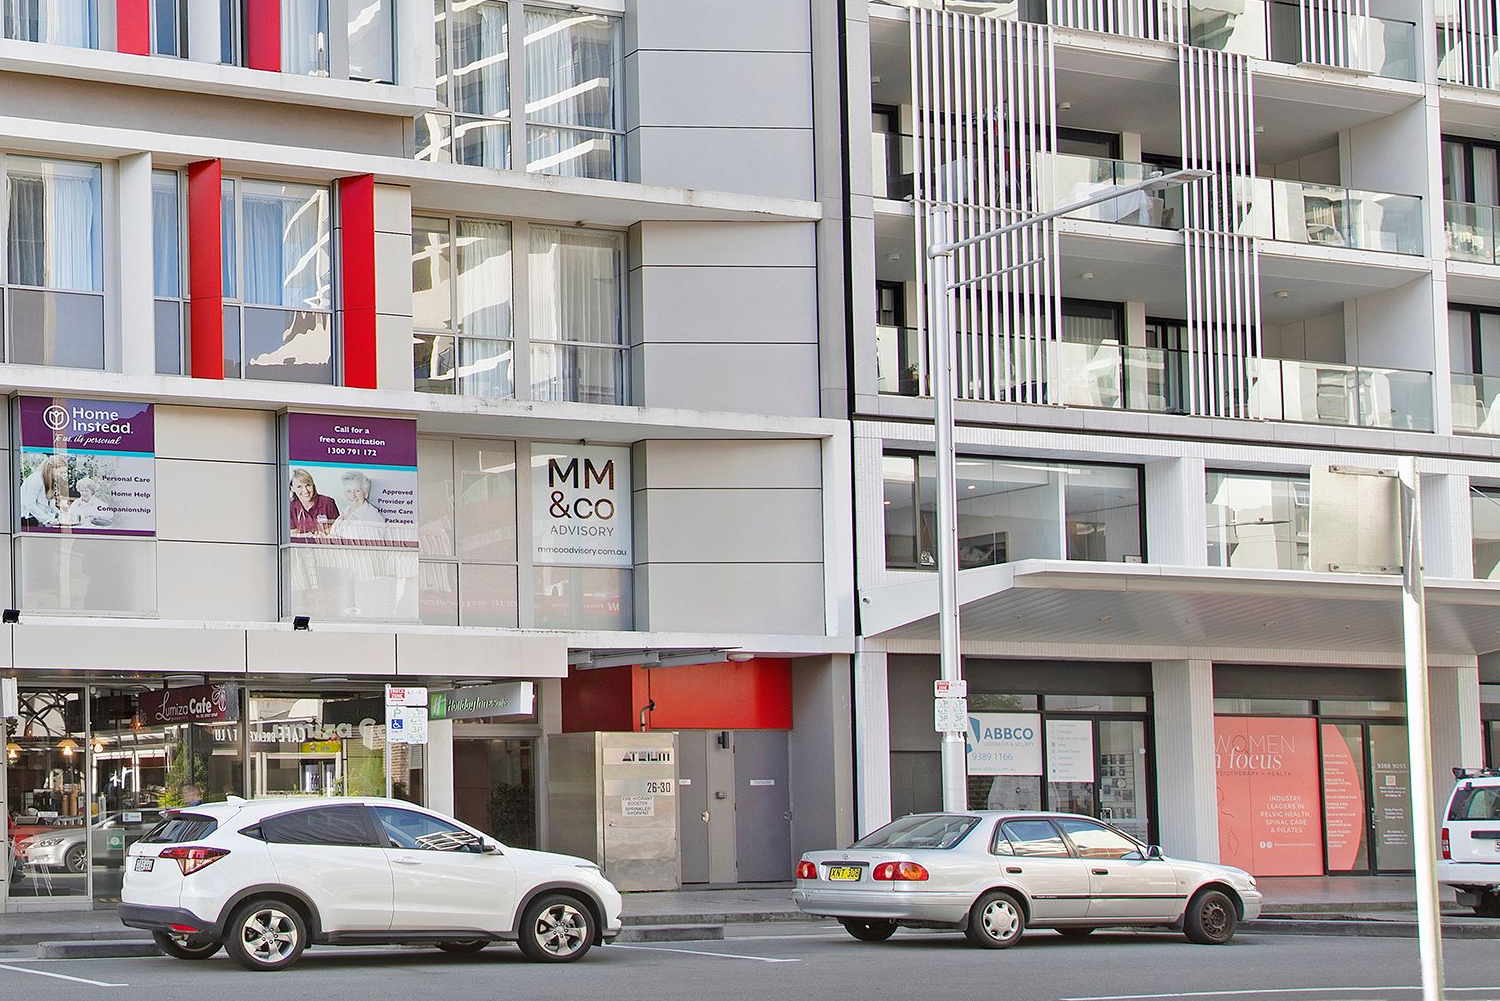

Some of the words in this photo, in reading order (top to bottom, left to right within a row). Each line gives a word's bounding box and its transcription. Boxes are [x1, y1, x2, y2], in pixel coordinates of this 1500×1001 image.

[72, 406, 119, 421] Home
[72, 419, 134, 434] Instead.
[334, 425, 350, 434] Call
[350, 426, 363, 434] for
[83, 436, 122, 446] personal
[319, 435, 336, 443] free
[336, 437, 386, 446] consultation
[327, 447, 346, 455] 1300
[347, 448, 360, 456] 791
[363, 448, 377, 456] 172
[548, 457, 615, 491] MM
[133, 491, 151, 499] Help
[382, 488, 414, 496] Approved
[96, 505, 152, 514] Companionship
[548, 490, 615, 521] &CO
[384, 517, 414, 525] Packages
[550, 525, 615, 537] ADVISORY
[537, 546, 627, 557] mmcoadvisory.com.au
[155, 691, 189, 721] Lumiza
[189, 697, 212, 715] Cafe
[447, 698, 474, 713] Holiday
[475, 696, 488, 709] Inn
[983, 727, 1034, 740] ABBCO
[1214, 734, 1295, 754] WOMEN
[622, 751, 670, 762] ATRIUM
[972, 752, 992, 761] 9389
[994, 752, 1013, 761] 1166
[1229, 744, 1282, 769] focus
[647, 782, 671, 793] 26-30
[831, 868, 845, 879] XNT
